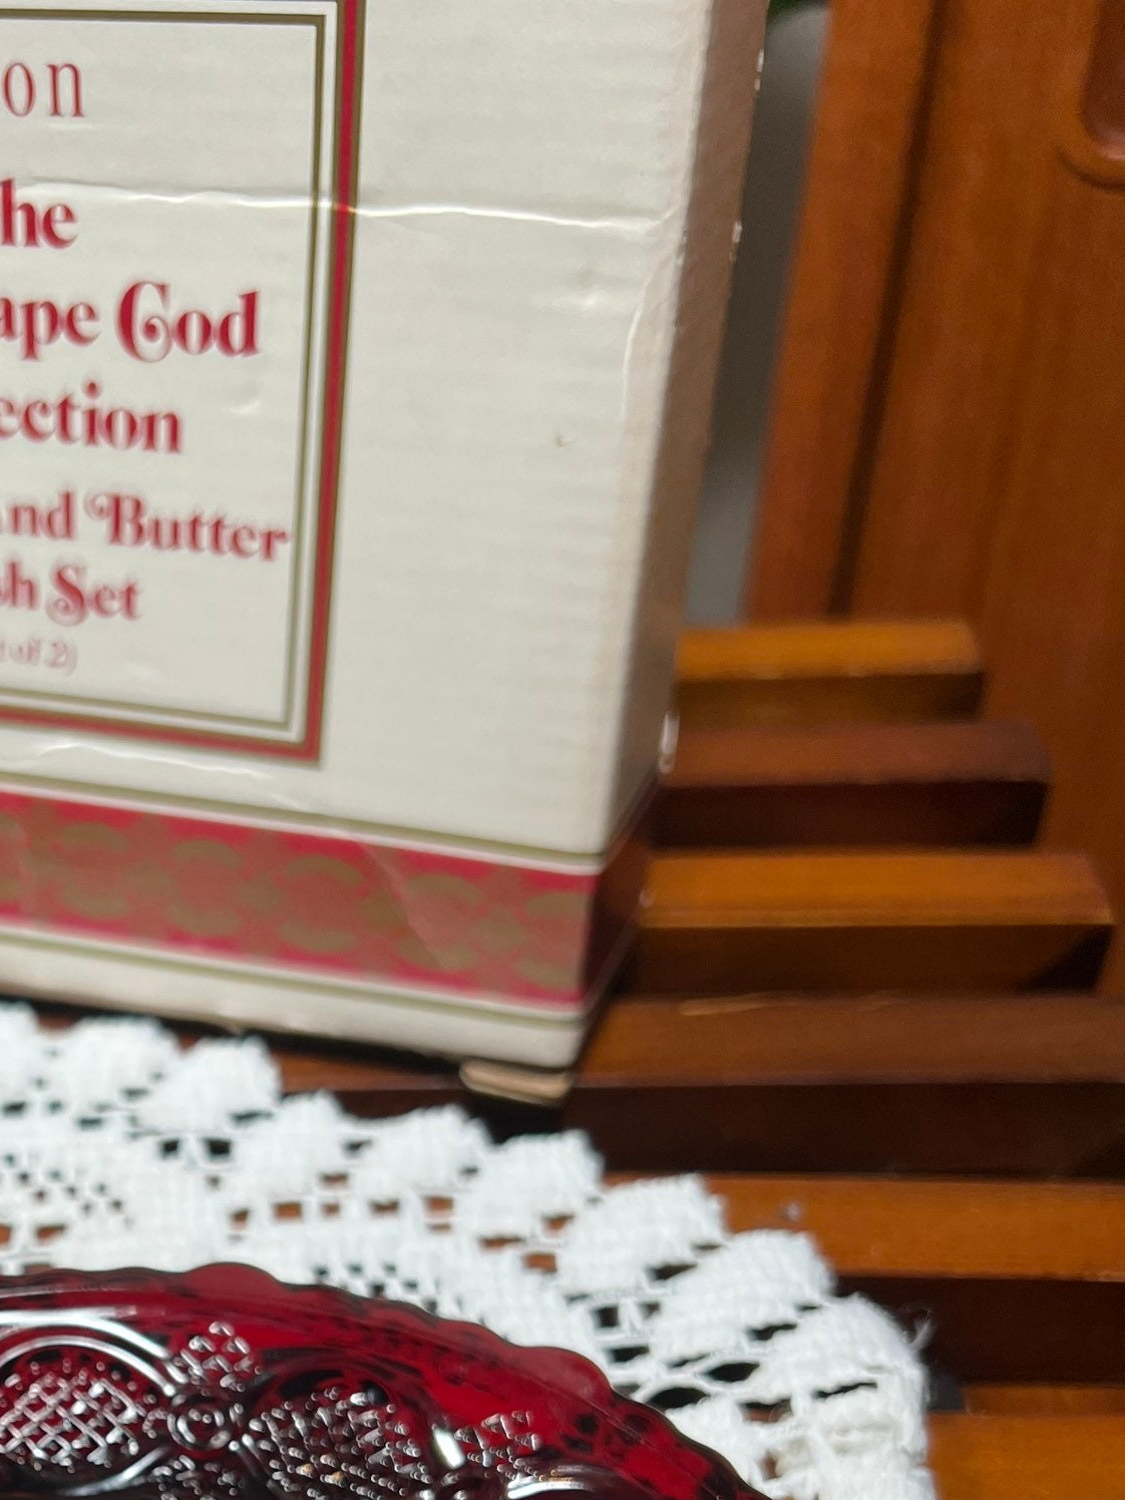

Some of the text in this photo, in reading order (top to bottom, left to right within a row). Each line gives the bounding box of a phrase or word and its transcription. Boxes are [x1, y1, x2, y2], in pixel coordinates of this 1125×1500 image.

[115, 280, 260, 361] Cod
[85, 490, 289, 561] Butter
[46, 562, 142, 626] Set
[9, 634, 42, 666] of
